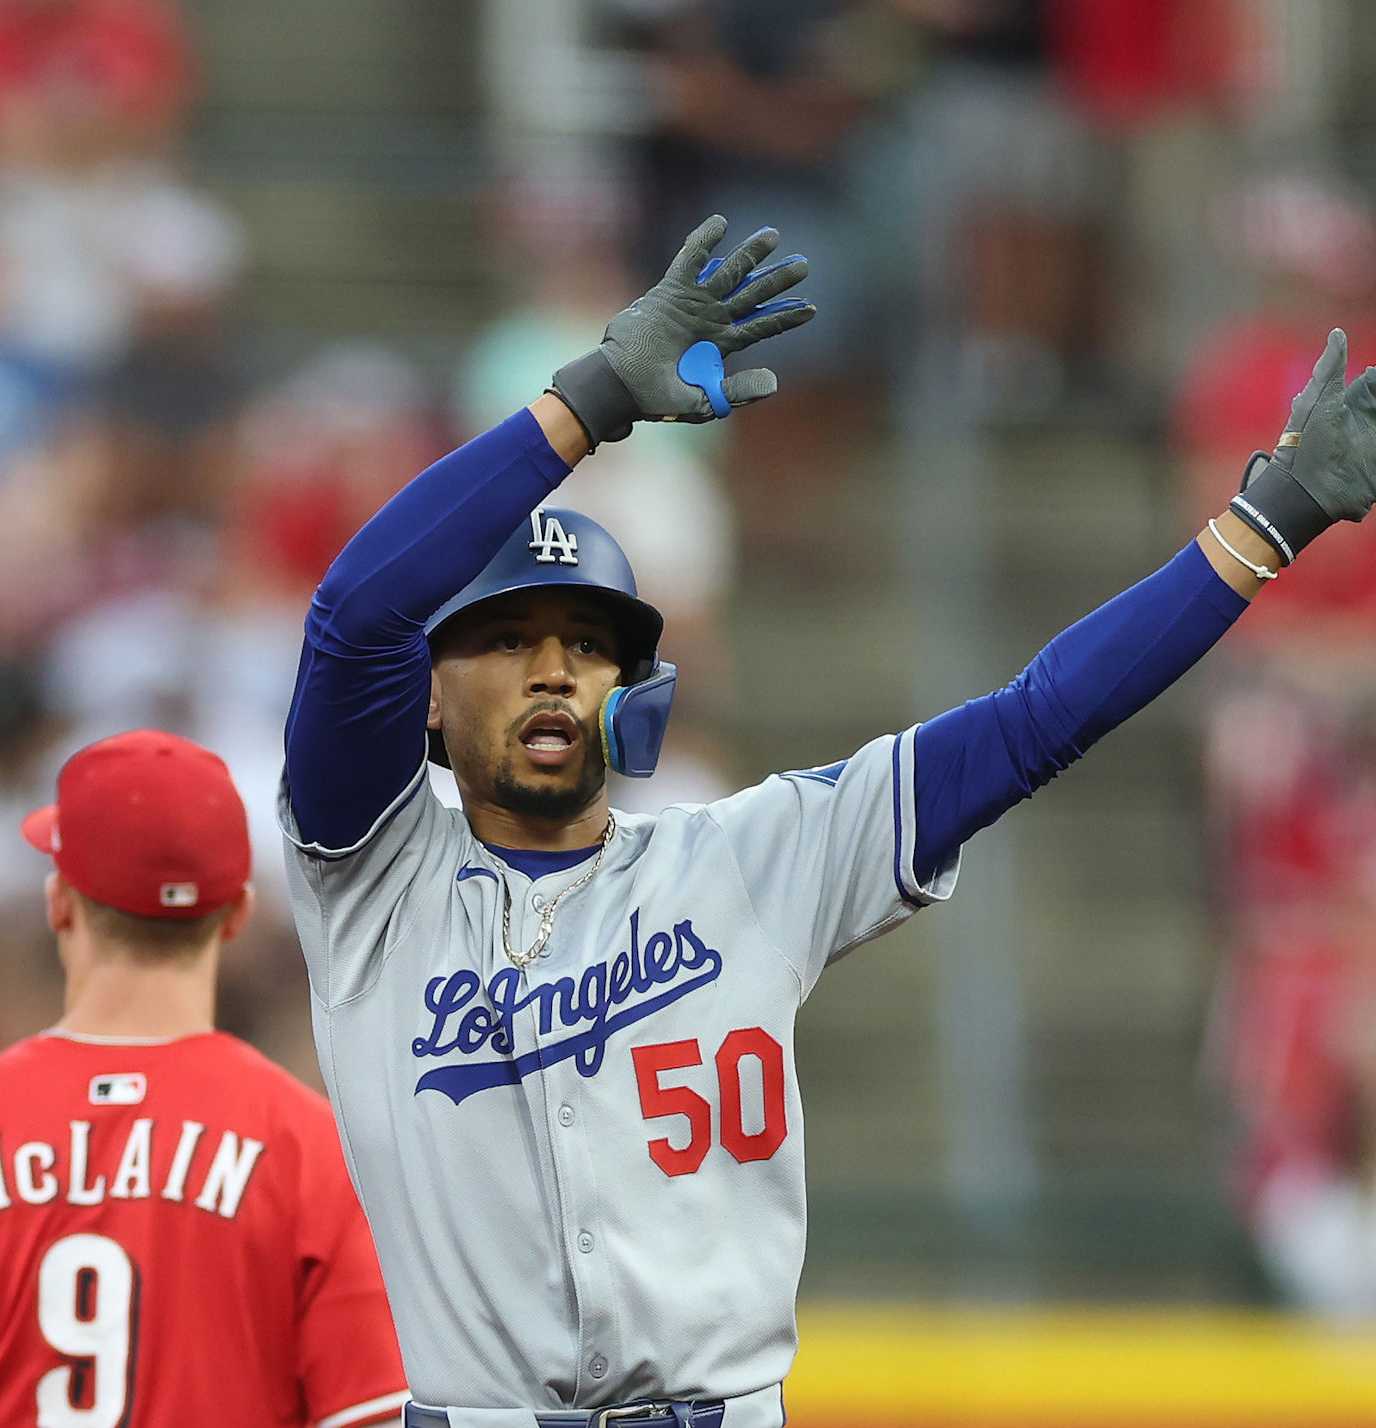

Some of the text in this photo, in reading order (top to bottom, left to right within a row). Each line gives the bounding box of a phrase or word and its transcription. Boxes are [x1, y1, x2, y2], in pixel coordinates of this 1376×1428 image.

[529, 508, 578, 564] LA
[487, 907, 721, 1077] Angeles
[630, 1026, 788, 1178] 50
